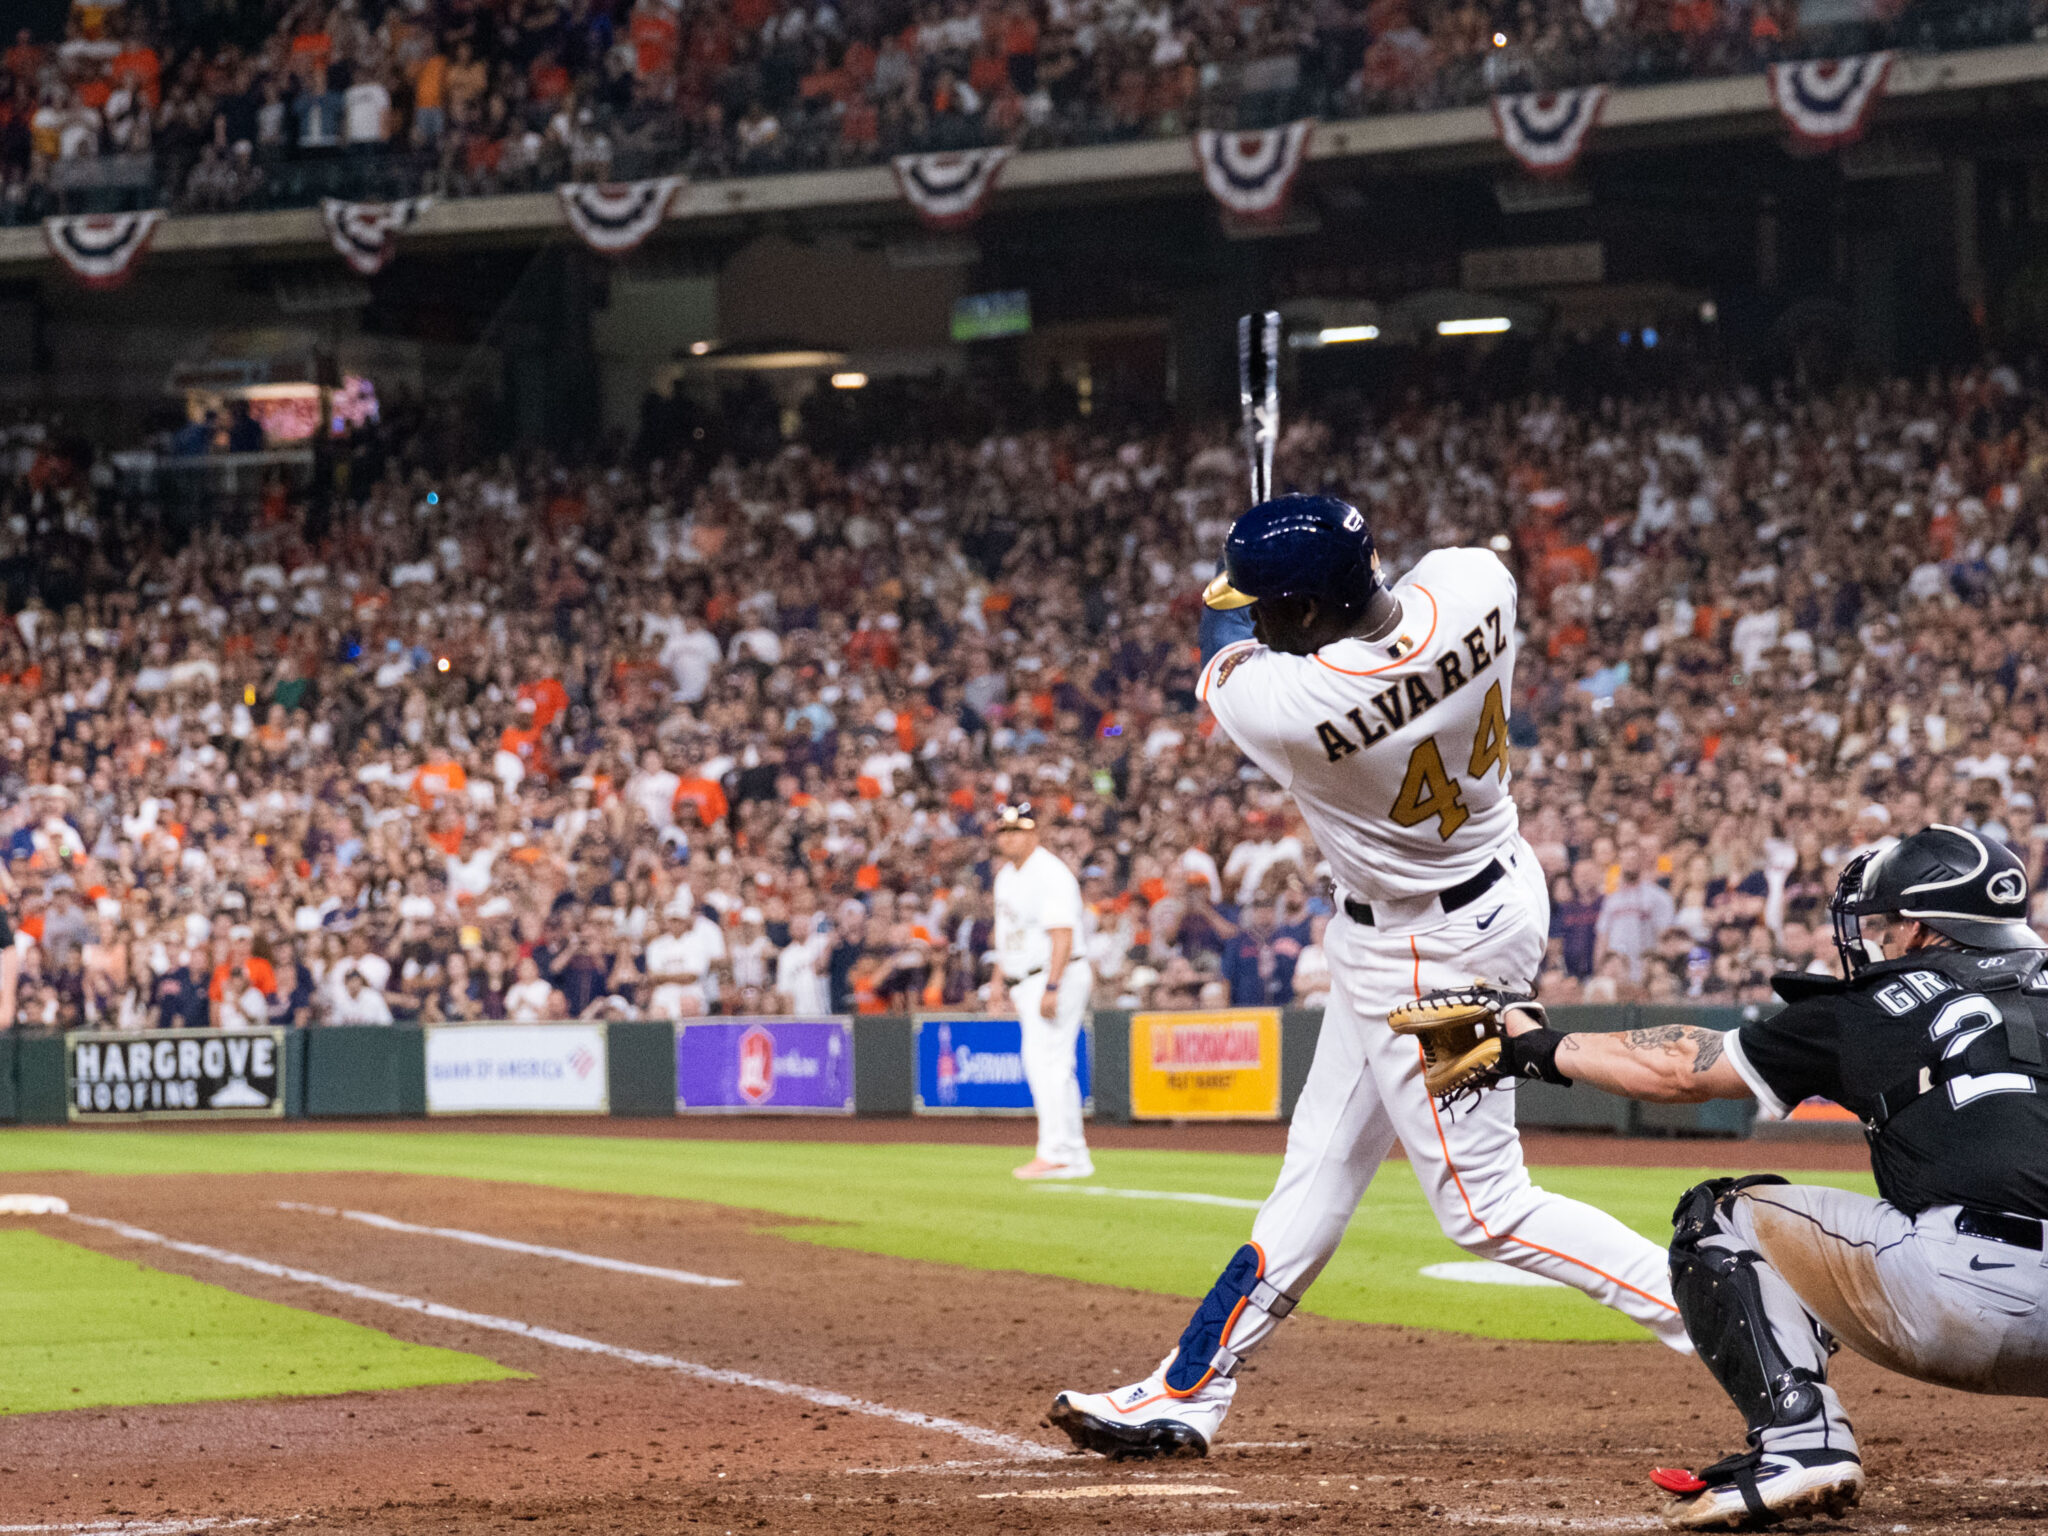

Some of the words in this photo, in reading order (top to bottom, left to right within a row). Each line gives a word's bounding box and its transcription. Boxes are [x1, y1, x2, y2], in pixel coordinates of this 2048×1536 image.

[1315, 607, 1507, 762] ALVAREZ
[1389, 679, 1510, 842] 44
[76, 1037, 275, 1083] HARGROVE
